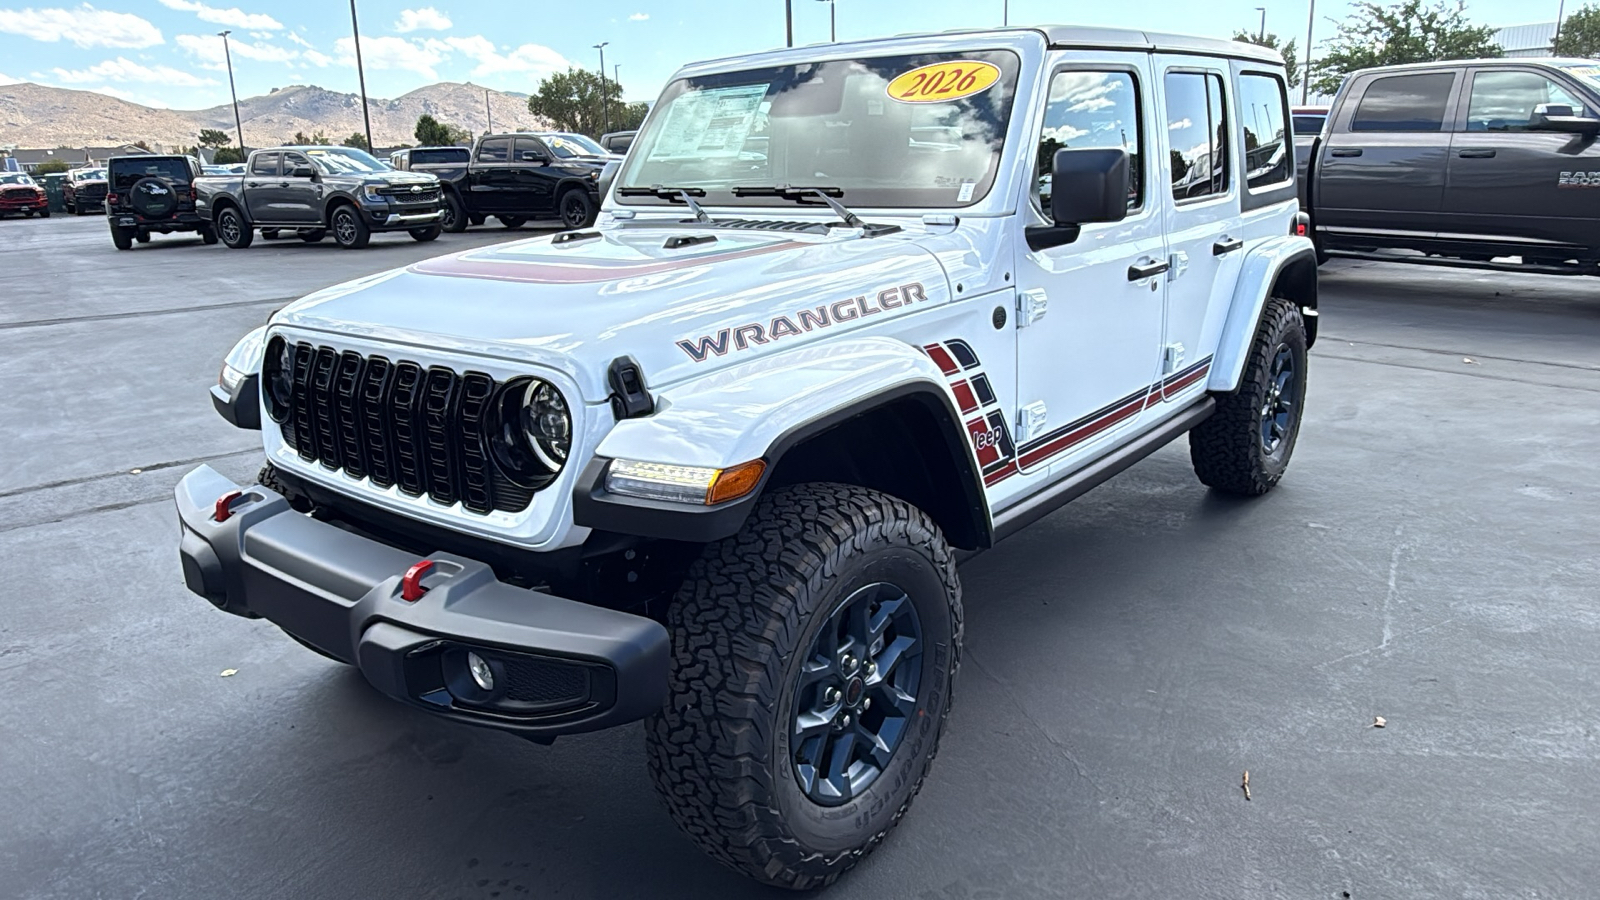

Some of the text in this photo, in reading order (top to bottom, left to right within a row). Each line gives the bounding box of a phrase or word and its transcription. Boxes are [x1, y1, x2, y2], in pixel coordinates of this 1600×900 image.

[900, 66, 985, 97] 2026
[675, 282, 928, 362] WRANGLER
[973, 426, 1002, 450] Jeep
